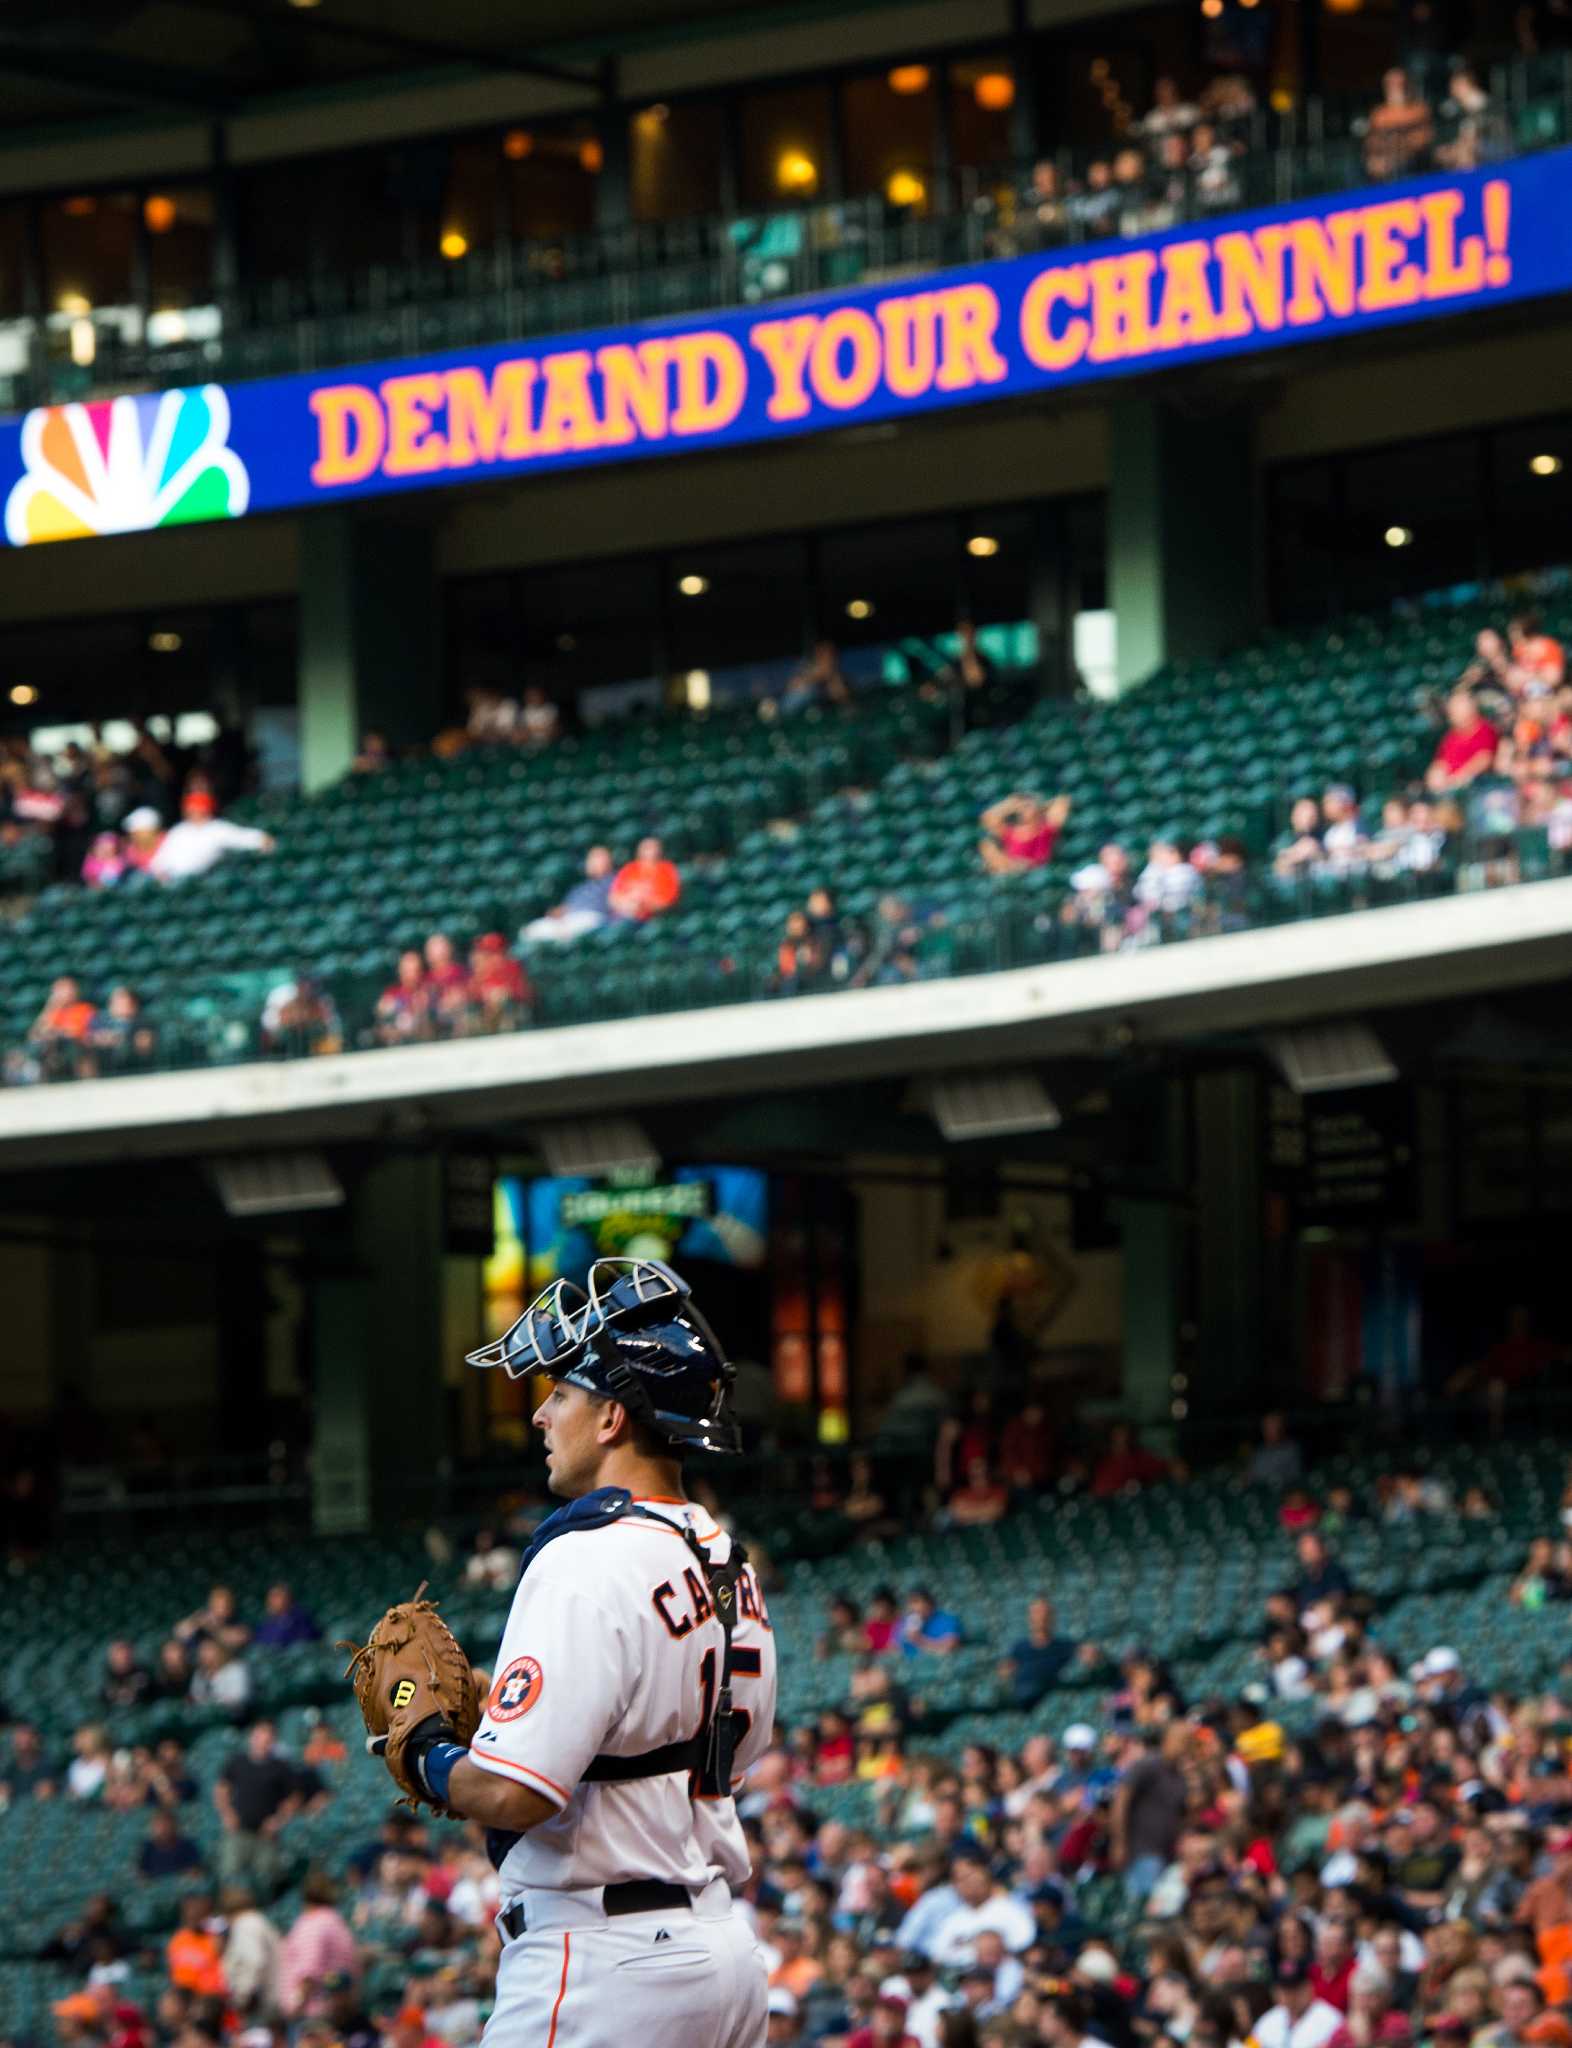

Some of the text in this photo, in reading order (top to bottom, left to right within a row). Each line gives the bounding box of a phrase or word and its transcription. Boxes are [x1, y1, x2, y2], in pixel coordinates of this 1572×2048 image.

[310, 181, 1510, 486] DEMAND YOUR CHANNEL!
[688, 1646, 761, 1800] 15
